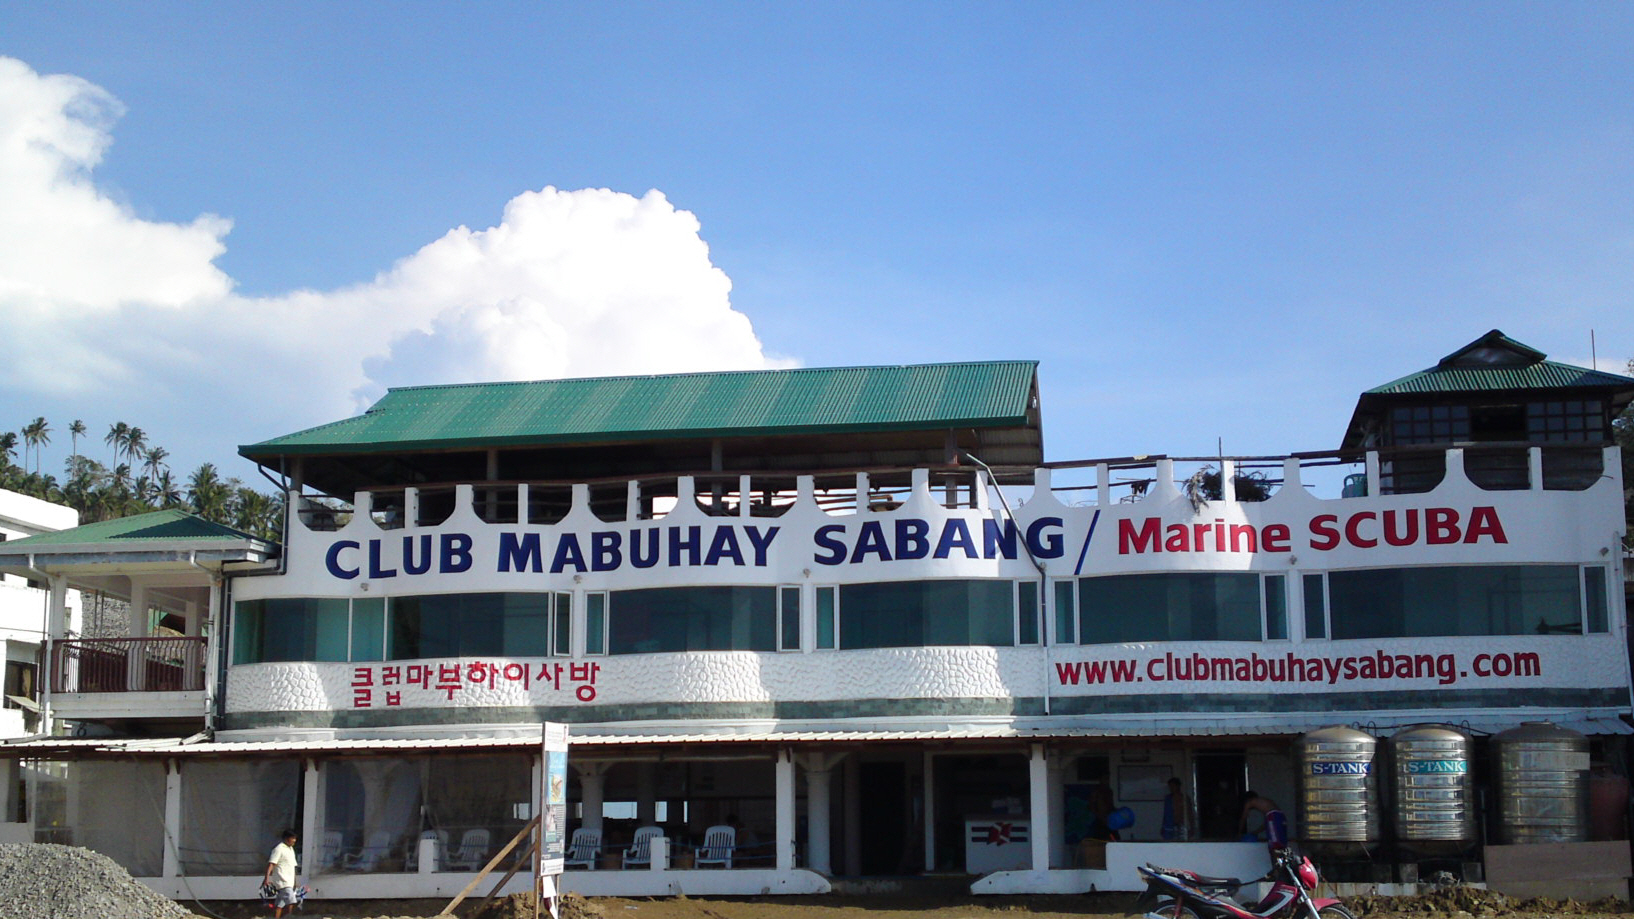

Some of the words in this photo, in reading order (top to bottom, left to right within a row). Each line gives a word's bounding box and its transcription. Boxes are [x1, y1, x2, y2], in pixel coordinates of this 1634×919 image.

[325, 533, 473, 579] CLUB
[497, 526, 780, 573] MABUHAY
[813, 516, 1065, 566] SABANG
[1118, 517, 1291, 555] Marine
[1309, 506, 1508, 551] SCUBA
[1313, 762, 1369, 774] S-TANK
[1408, 760, 1464, 773] S-TANK
